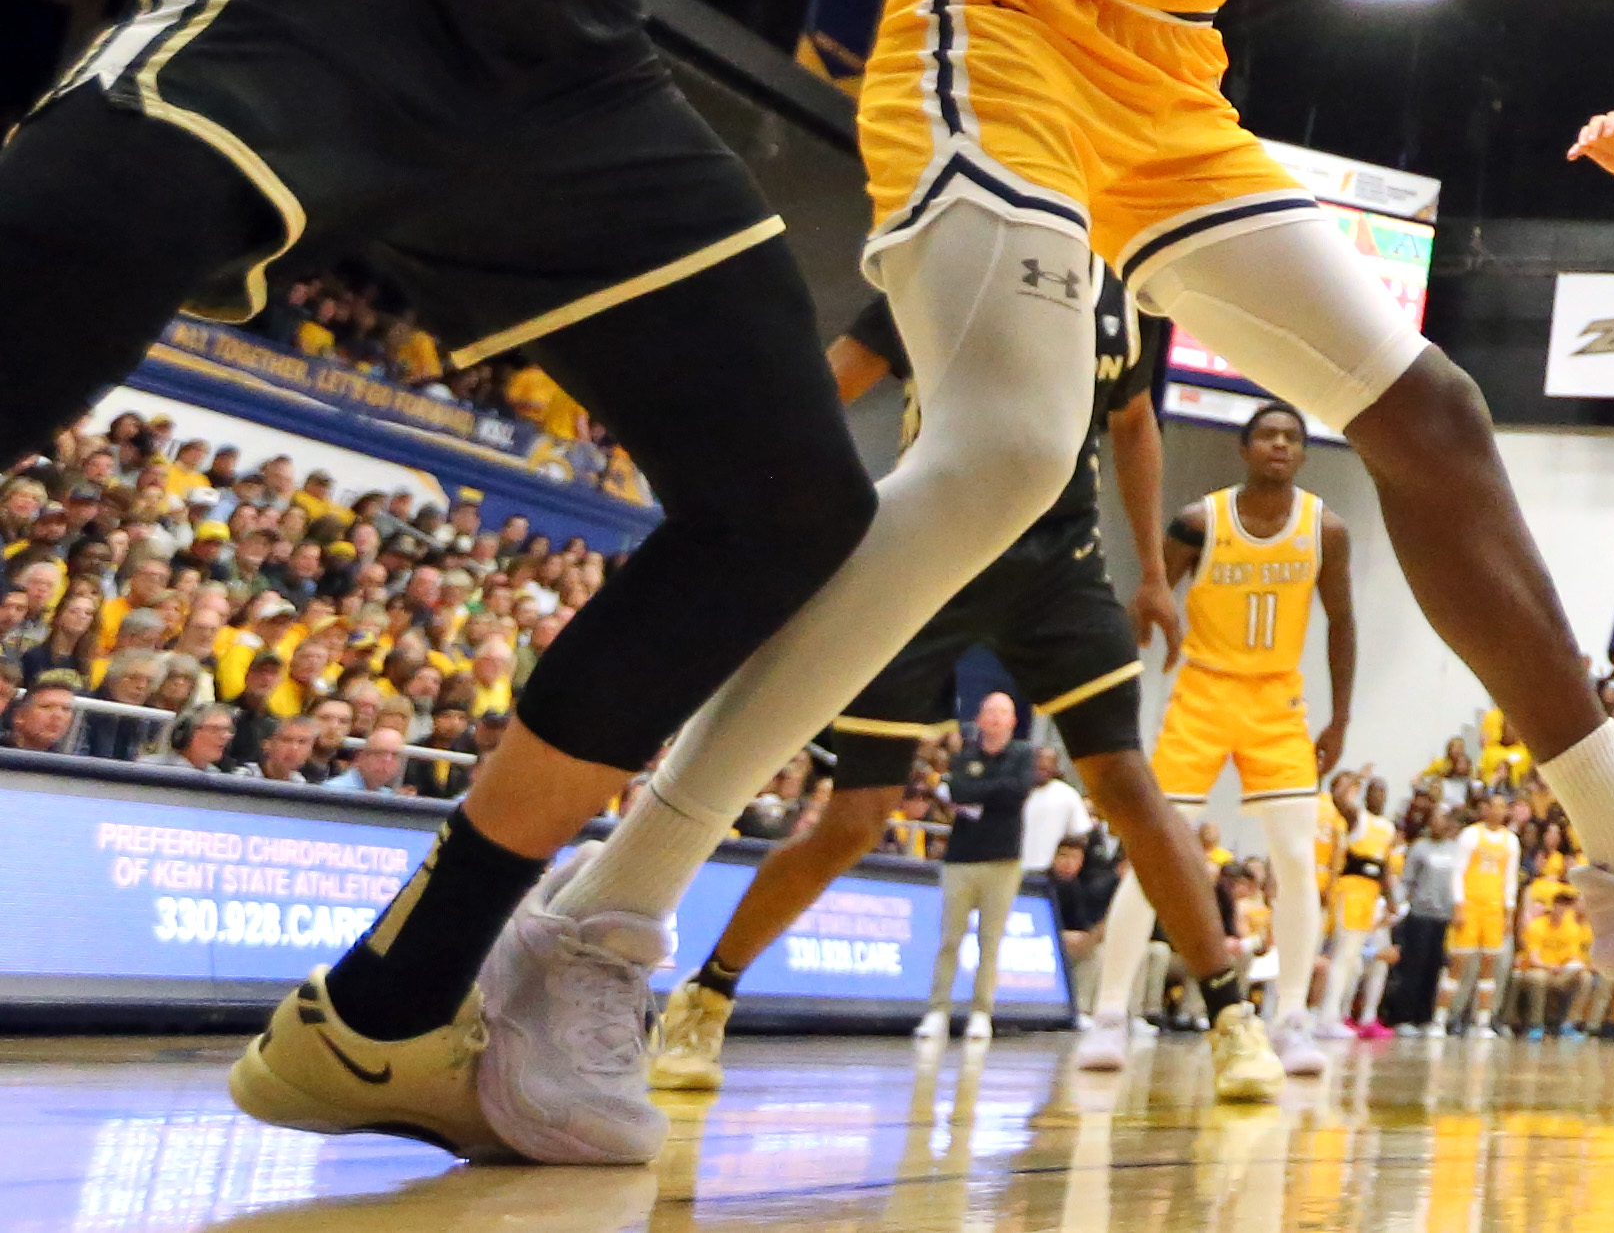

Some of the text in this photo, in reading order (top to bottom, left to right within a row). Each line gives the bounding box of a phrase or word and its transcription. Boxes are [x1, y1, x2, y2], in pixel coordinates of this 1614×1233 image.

[1246, 591, 1278, 650] 11
[99, 822, 409, 872] PREFERRED CHIROPRACTOR
[113, 856, 149, 888] OF
[153, 859, 217, 892] KENT
[220, 863, 291, 897] STATE
